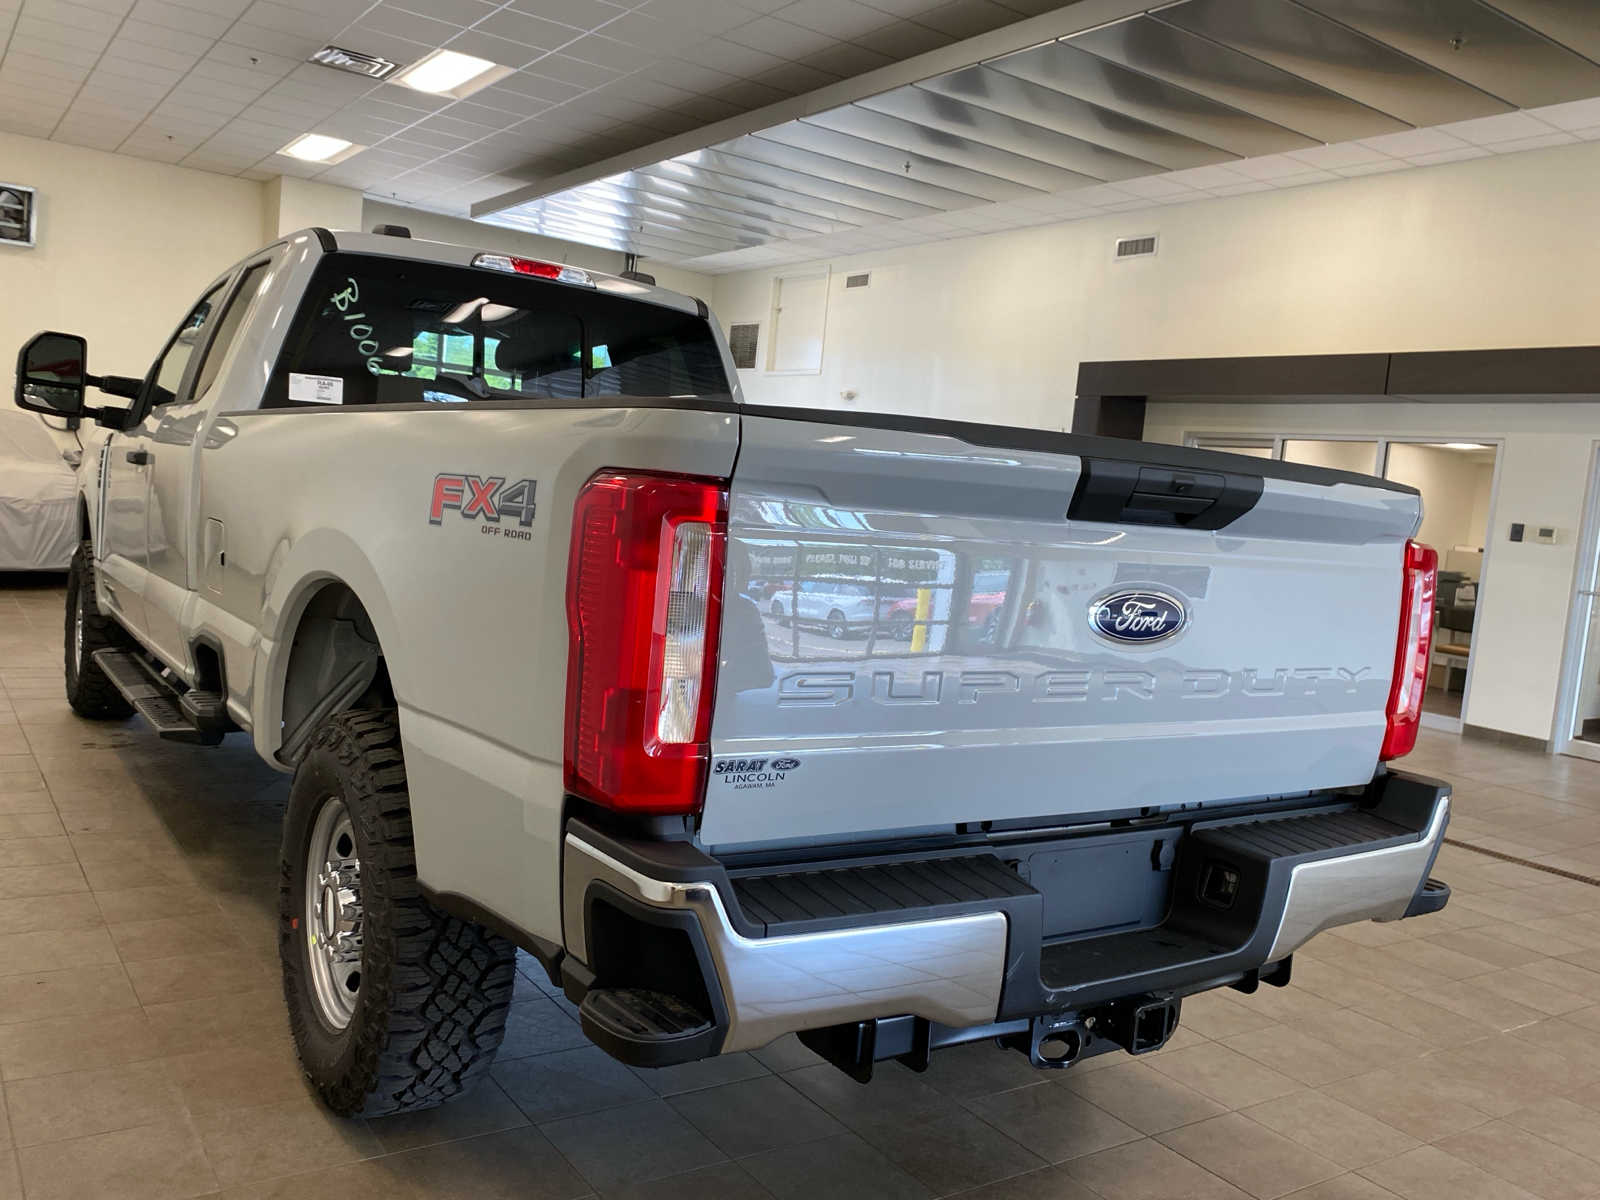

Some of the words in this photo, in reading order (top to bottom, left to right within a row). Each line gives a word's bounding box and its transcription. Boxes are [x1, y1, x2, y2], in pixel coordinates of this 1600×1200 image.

[429, 473, 537, 527] FX4
[481, 525, 501, 536] OFF
[504, 529, 532, 540] ROAD
[1115, 601, 1168, 631] Ford
[778, 671, 1157, 708] SUPER
[1181, 666, 1372, 699] DUTY
[713, 759, 769, 775] SARAT
[724, 772, 785, 783] LINCOLN
